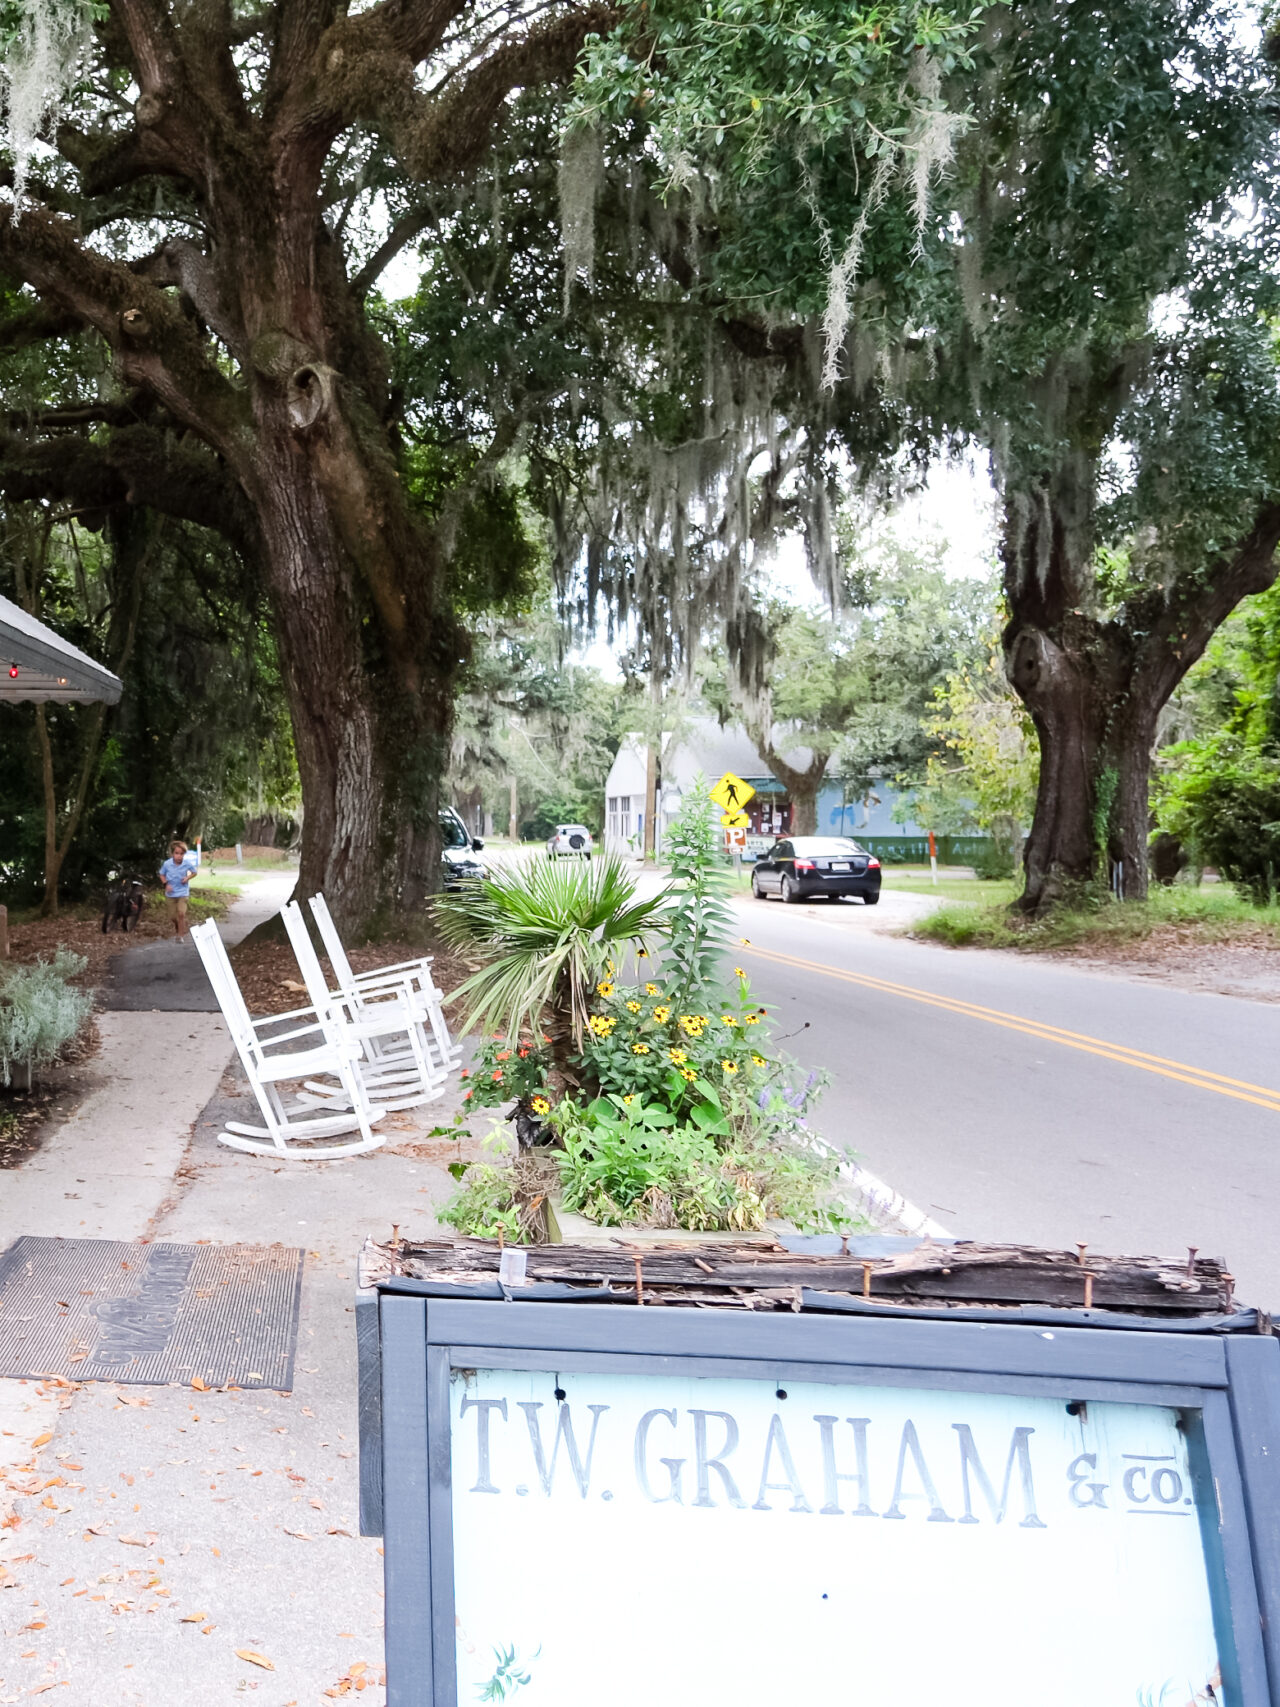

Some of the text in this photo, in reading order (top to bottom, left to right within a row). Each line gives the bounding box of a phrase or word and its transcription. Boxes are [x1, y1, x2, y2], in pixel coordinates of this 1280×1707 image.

[726, 829, 744, 848] P
[460, 1394, 1193, 1529] T.W. GRAHAM & CO.
